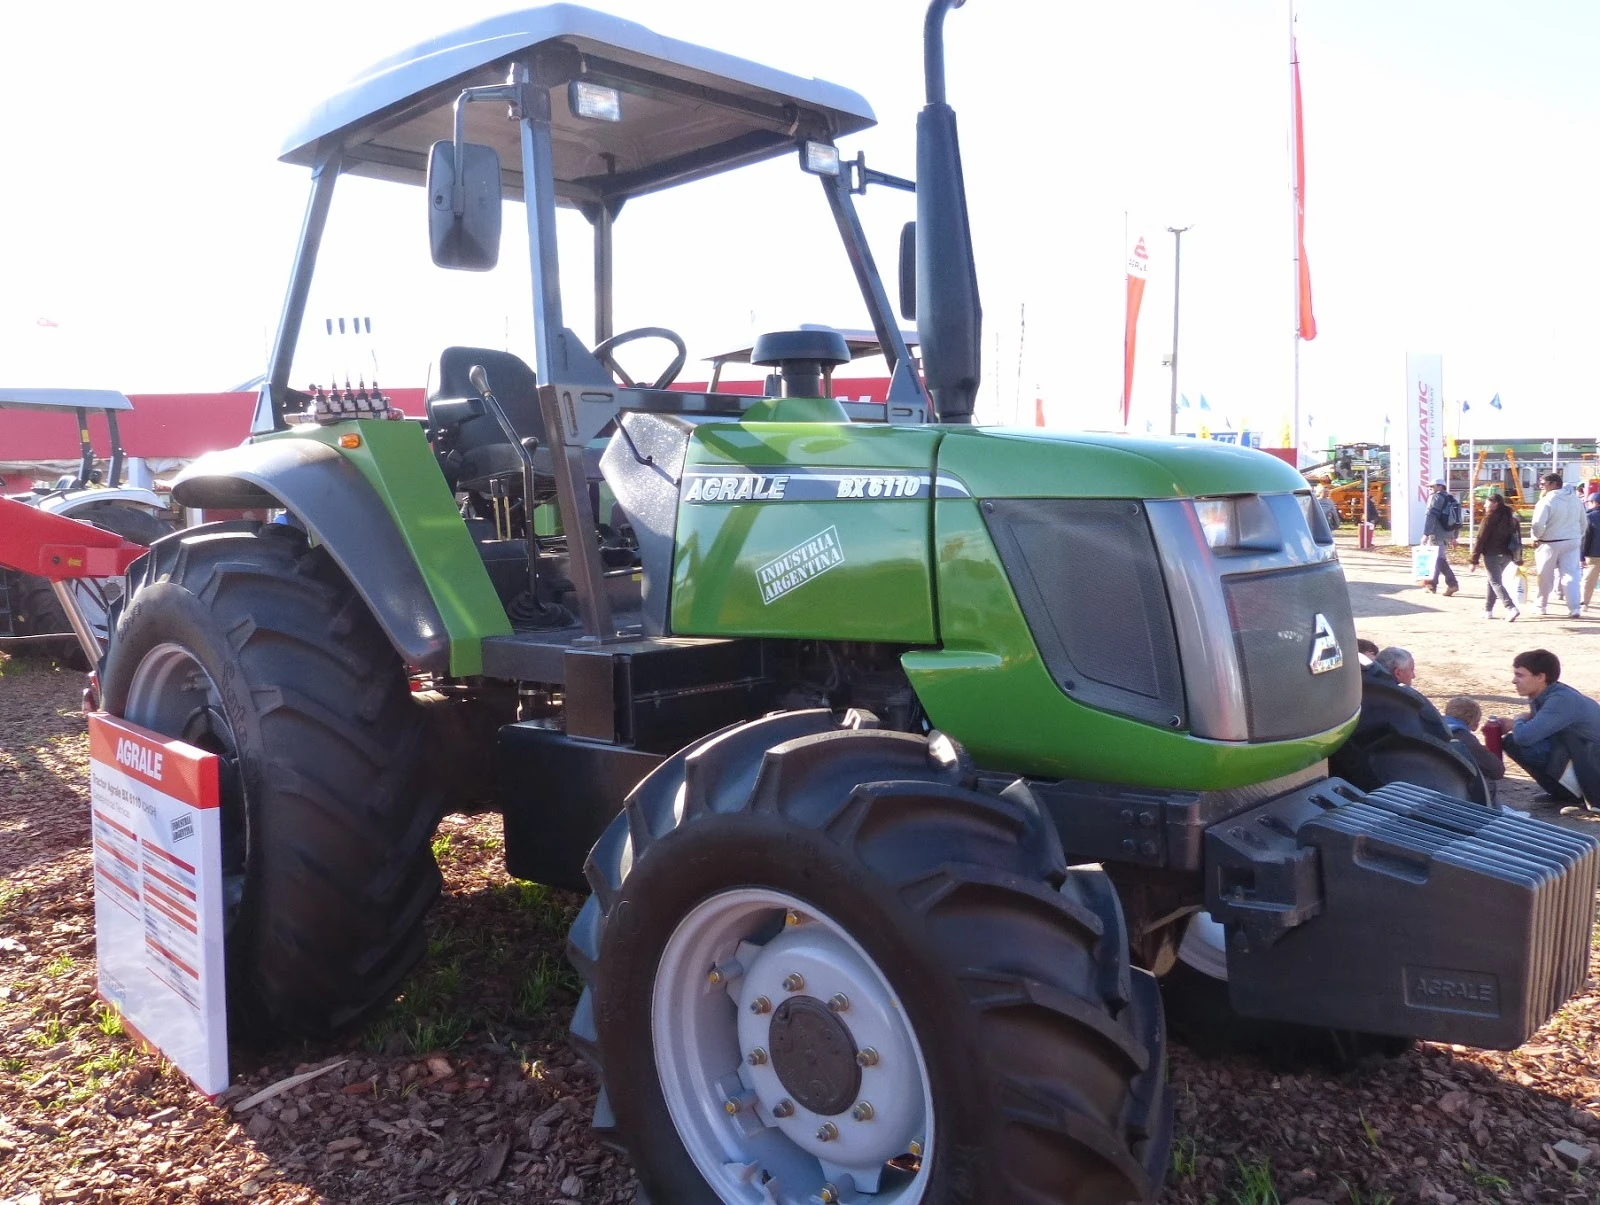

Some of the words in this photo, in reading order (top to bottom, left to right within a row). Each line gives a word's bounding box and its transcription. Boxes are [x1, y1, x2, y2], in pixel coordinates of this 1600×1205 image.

[1418, 380, 1430, 504] ZIMMATIC
[686, 476, 790, 501] AGRALE
[761, 533, 834, 584] INDUSTRIA
[765, 547, 841, 601] ARGENTINA
[116, 737, 163, 781] AGRALE
[1417, 978, 1493, 1001] AGRALE
